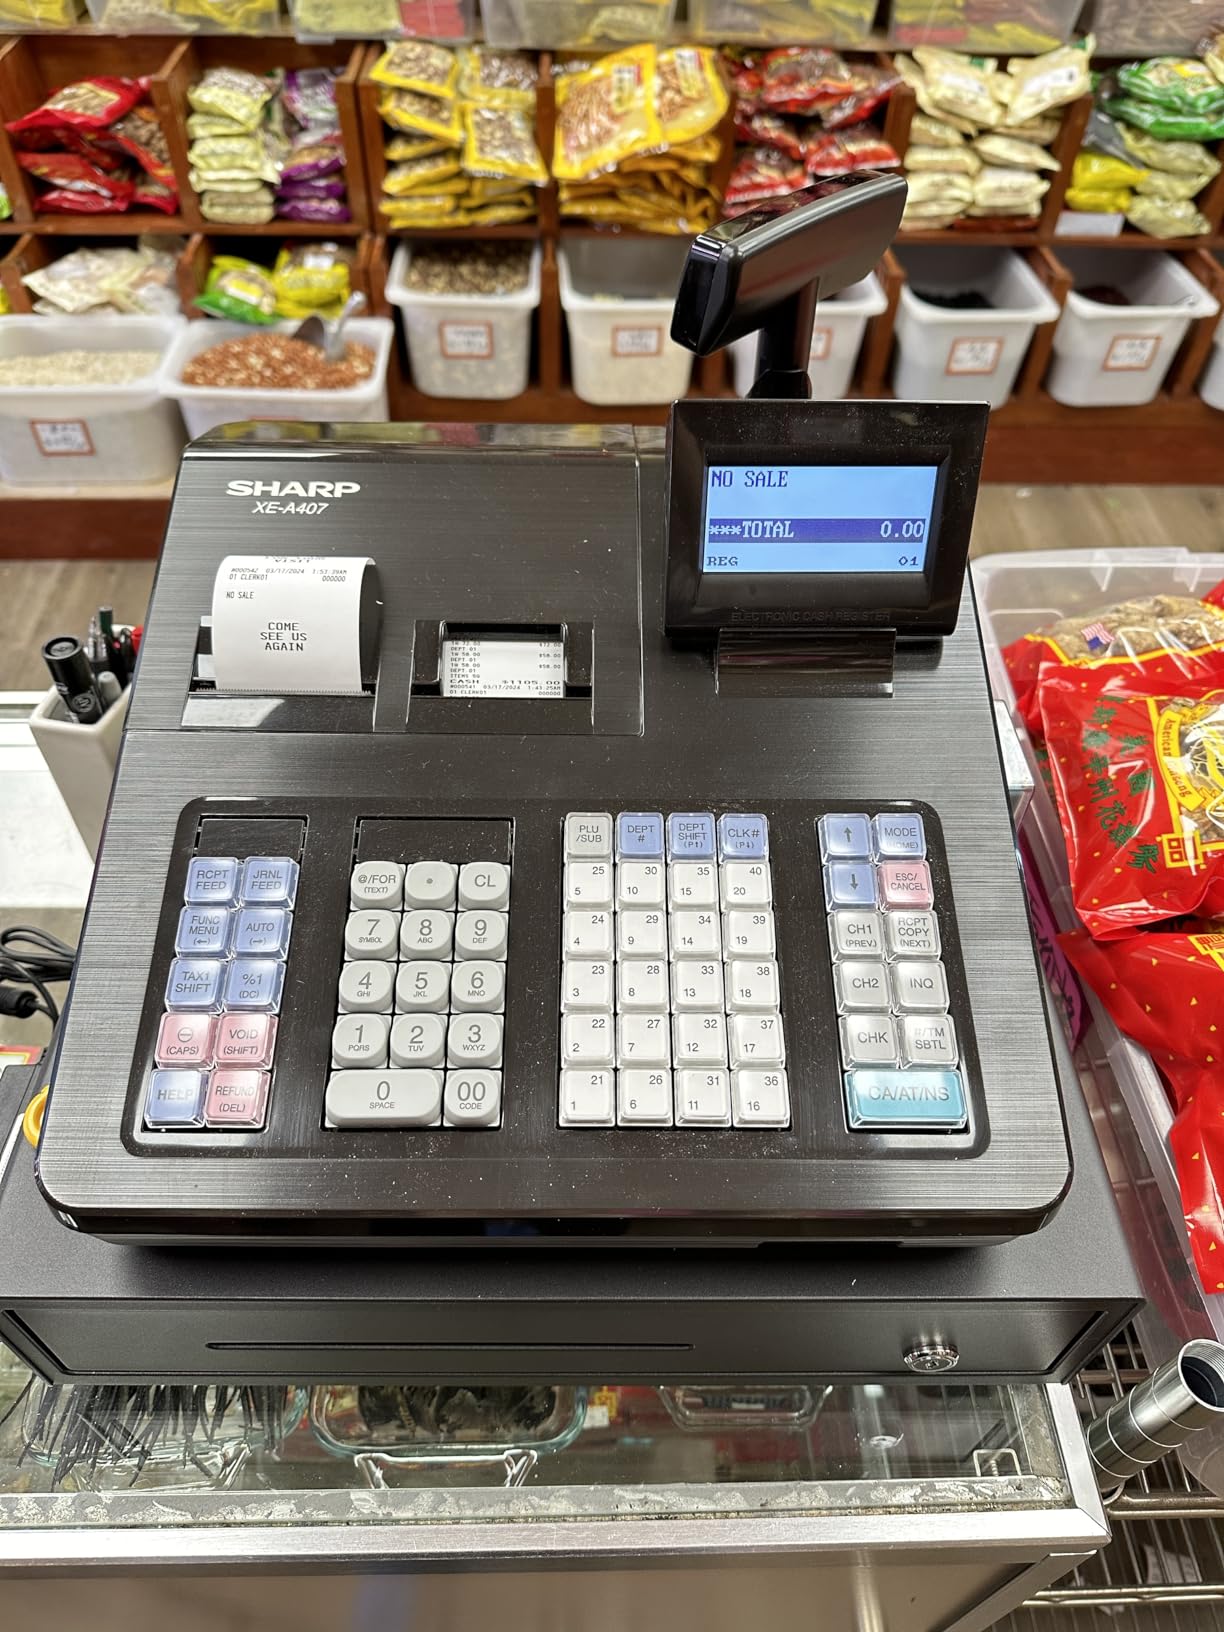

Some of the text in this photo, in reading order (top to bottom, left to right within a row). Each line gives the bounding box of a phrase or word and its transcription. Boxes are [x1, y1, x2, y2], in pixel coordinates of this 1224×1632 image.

[712, 471, 788, 487] NO SALE
[226, 480, 361, 497] SHARP
[252, 501, 329, 515] XE-A407
[881, 521, 924, 538] 0.00
[707, 557, 918, 566] REG 01
[731, 612, 890, 622] ELECTRONIC CASH REGISTER
[268, 622, 299, 631] COME
[261, 632, 307, 641] SEE US
[265, 642, 304, 651] AGAIN
[679, 823, 706, 832] DEPT
[678, 833, 707, 841] SHIFT
[885, 828, 917, 837] MODE
[197, 870, 229, 879] RCPT
[253, 870, 282, 879] JRNL
[592, 867, 605, 875] 25
[645, 867, 658, 875] 30
[697, 867, 710, 875] 35
[749, 867, 762, 875] 40
[358, 875, 396, 884] @/FOR
[475, 875, 496, 887] CL
[196, 882, 227, 890] FEED
[252, 881, 282, 890] FEED
[891, 883, 926, 891] CANCEL
[575, 888, 581, 896] 5
[627, 887, 638, 895] 10
[681, 888, 692, 896] 15
[733, 887, 746, 895] 20
[192, 916, 221, 925] FUNC
[591, 916, 604, 924] 24
[699, 916, 712, 924] 34
[753, 916, 766, 924] 39
[898, 918, 927, 926] RCPT
[189, 926, 219, 935] MENU
[246, 923, 275, 932] AUTO
[368, 919, 380, 935] 7
[420, 919, 432, 936] 8
[475, 920, 487, 937] 9
[848, 924, 872, 934] CH1
[898, 928, 929, 937] COPY
[628, 937, 634, 945] 9
[682, 937, 693, 945] 14
[900, 940, 931, 948] (NEXT)
[591, 966, 605, 975] 23
[647, 966, 660, 974] 28
[701, 966, 715, 975] 33
[757, 967, 770, 976] 38
[182, 972, 210, 981] TAX1
[242, 973, 262, 985] %1
[359, 972, 372, 990] 4
[415, 972, 428, 990] 5
[471, 971, 484, 989] 6
[852, 978, 879, 988] CH2
[910, 978, 934, 989] INQ
[176, 983, 211, 993] SHIFT
[573, 988, 580, 997] 3
[628, 988, 635, 997] 8
[684, 988, 696, 997] 13
[240, 991, 259, 999] (DC)
[740, 989, 752, 998] 18
[591, 1019, 606, 1029] 22
[647, 1019, 661, 1029] 27
[704, 1019, 718, 1029] 32
[760, 1020, 774, 1030] 37
[230, 1030, 258, 1039] VOID
[355, 1025, 364, 1043] 1
[410, 1026, 424, 1044] 2
[468, 1025, 481, 1043] 3
[858, 1032, 889, 1044] CHK
[572, 1043, 580, 1052] 2
[628, 1043, 635, 1052] 7
[687, 1043, 699, 1052] 12
[744, 1044, 756, 1053] 17
[915, 1040, 946, 1049] SBTL
[166, 1046, 199, 1055] (CAPS)
[224, 1046, 258, 1055] (SHIFT)
[591, 1076, 604, 1085] 21
[649, 1075, 663, 1085] 26
[707, 1076, 720, 1086] 31
[765, 1076, 779, 1086] 36
[157, 1089, 193, 1100] HELP
[216, 1086, 254, 1096] REFUND
[377, 1081, 391, 1100] 0
[457, 1082, 486, 1101] 00
[219, 1103, 246, 1113] (DEL)
[630, 1100, 637, 1110] 6
[688, 1101, 698, 1110] 11
[748, 1102, 760, 1111] 16
